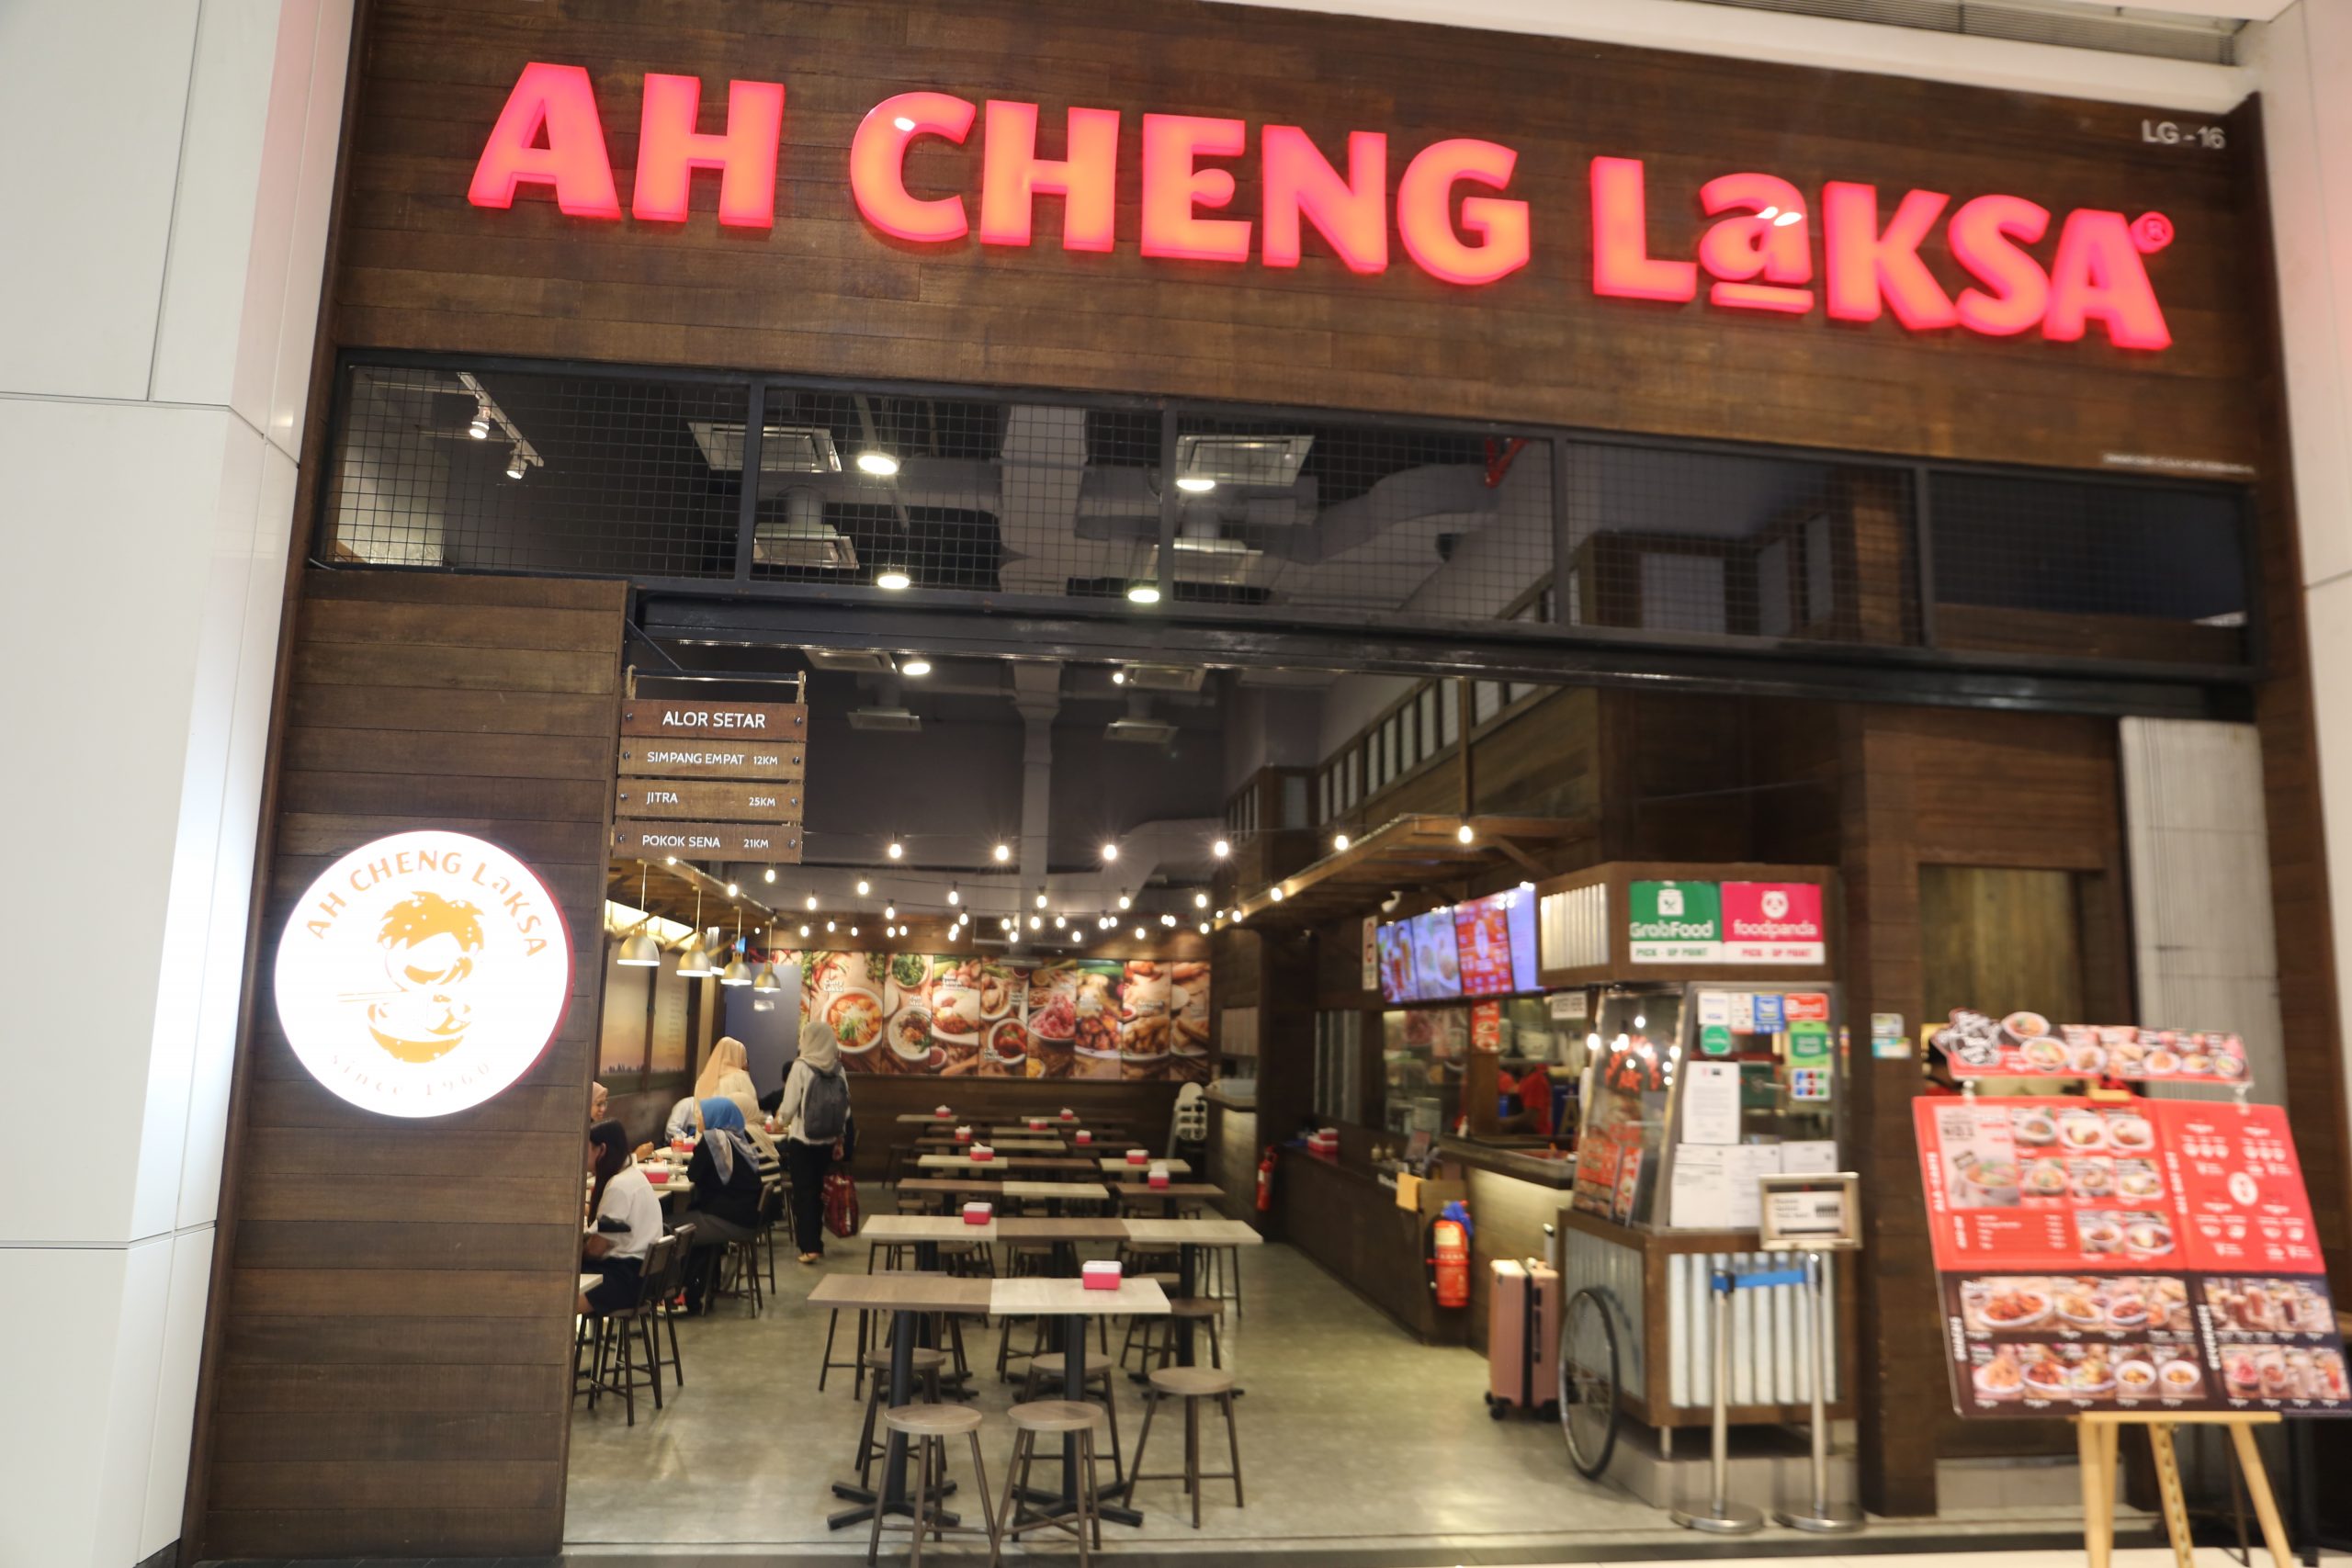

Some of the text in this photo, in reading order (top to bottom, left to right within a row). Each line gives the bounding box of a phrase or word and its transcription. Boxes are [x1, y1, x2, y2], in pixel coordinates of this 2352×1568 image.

[469, 62, 786, 227] AH
[849, 92, 1531, 285] CHENG
[662, 711, 765, 728] ALOR SETAR
[647, 751, 778, 765] SIMPANG EMPAT 12KM
[646, 792, 775, 807] JITRA 25KM
[642, 834, 769, 848] POKOK SENA 21KM
[306, 891, 347, 940] AH
[349, 850, 462, 892] CHENG
[1629, 919, 1714, 939] GrabFood
[1733, 919, 1818, 940] foodpanda
